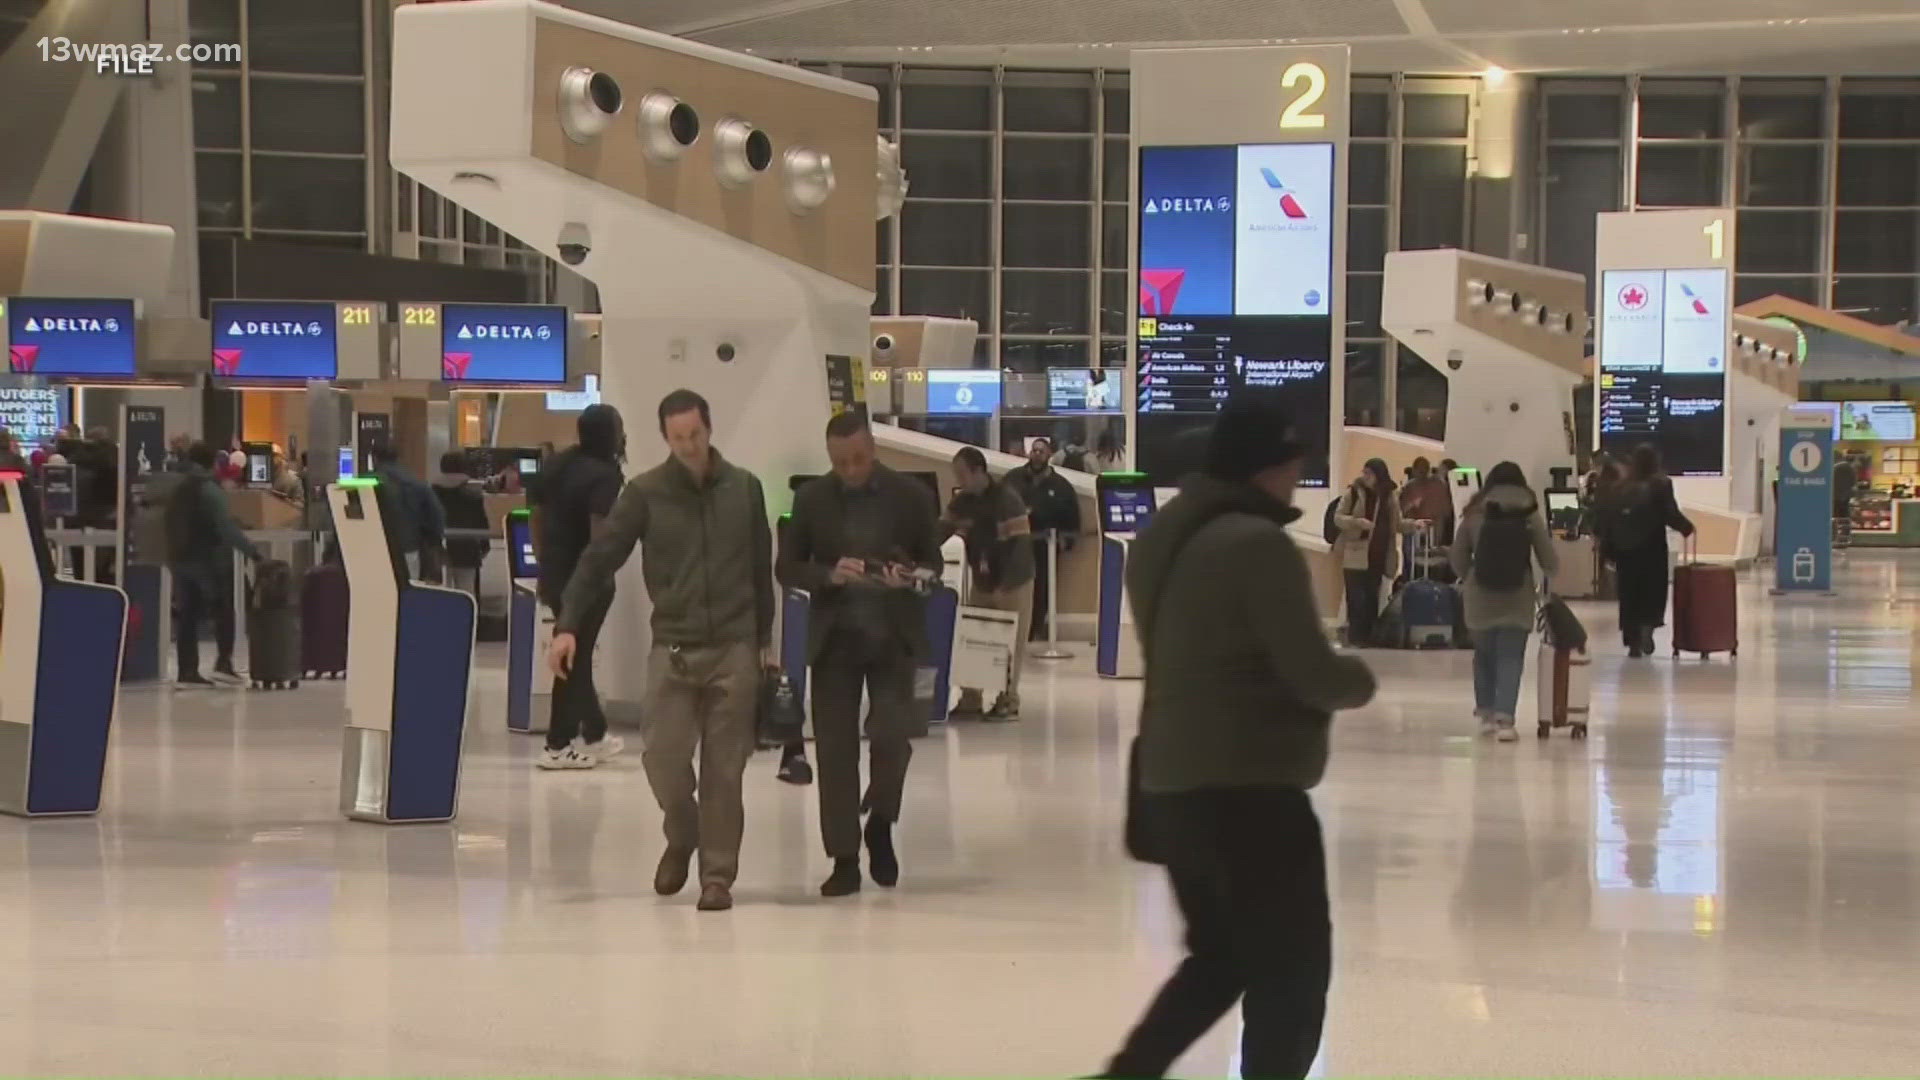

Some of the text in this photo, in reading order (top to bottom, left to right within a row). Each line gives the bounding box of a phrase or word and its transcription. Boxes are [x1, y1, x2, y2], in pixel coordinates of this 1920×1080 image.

[1279, 62, 1327, 129] 2
[1161, 198, 1214, 213] DELTA
[1703, 219, 1723, 260] 1
[343, 306, 371, 325] 211
[404, 306, 437, 325] 212
[42, 317, 101, 332] DELTA
[246, 321, 304, 336] DELTA
[476, 324, 533, 339] DELTA
[1158, 322, 1195, 332] Check-in
[1246, 360, 1325, 372] Newark Liberty
[0, 388, 57, 400] UTGERS
[0, 401, 56, 412] UPPORTS
[0, 412, 55, 423] TUDENT
[1800, 447, 1809, 467] 1
